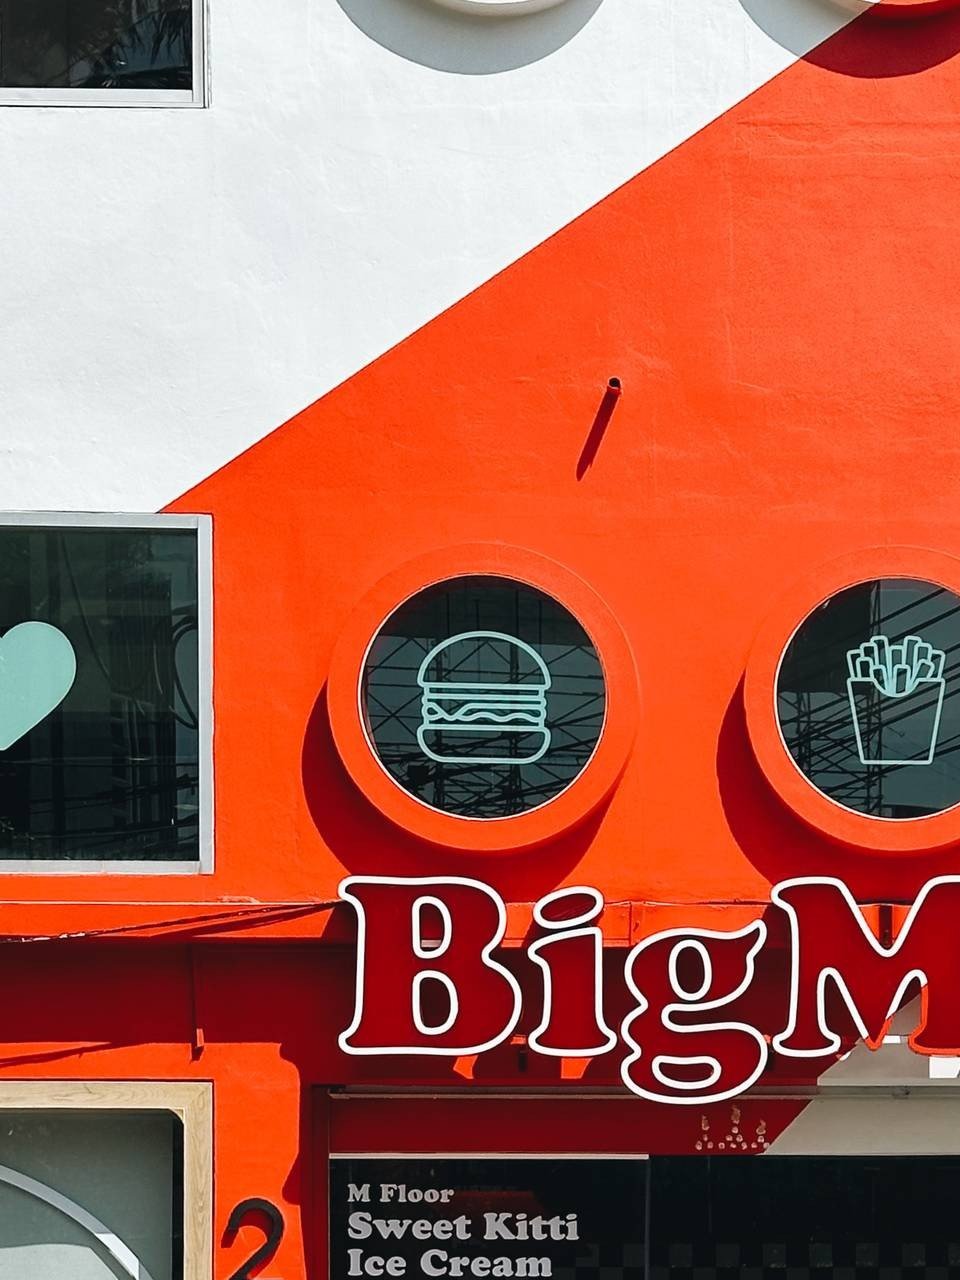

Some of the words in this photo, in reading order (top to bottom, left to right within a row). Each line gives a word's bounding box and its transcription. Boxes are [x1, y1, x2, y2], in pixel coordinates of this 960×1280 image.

[347, 1183, 371, 1203] M
[379, 1183, 456, 1203] Floor
[347, 1211, 472, 1240] Sweet
[483, 1212, 580, 1241] Kitti
[347, 1248, 407, 1277] Ice
[420, 1249, 553, 1278] Cream
